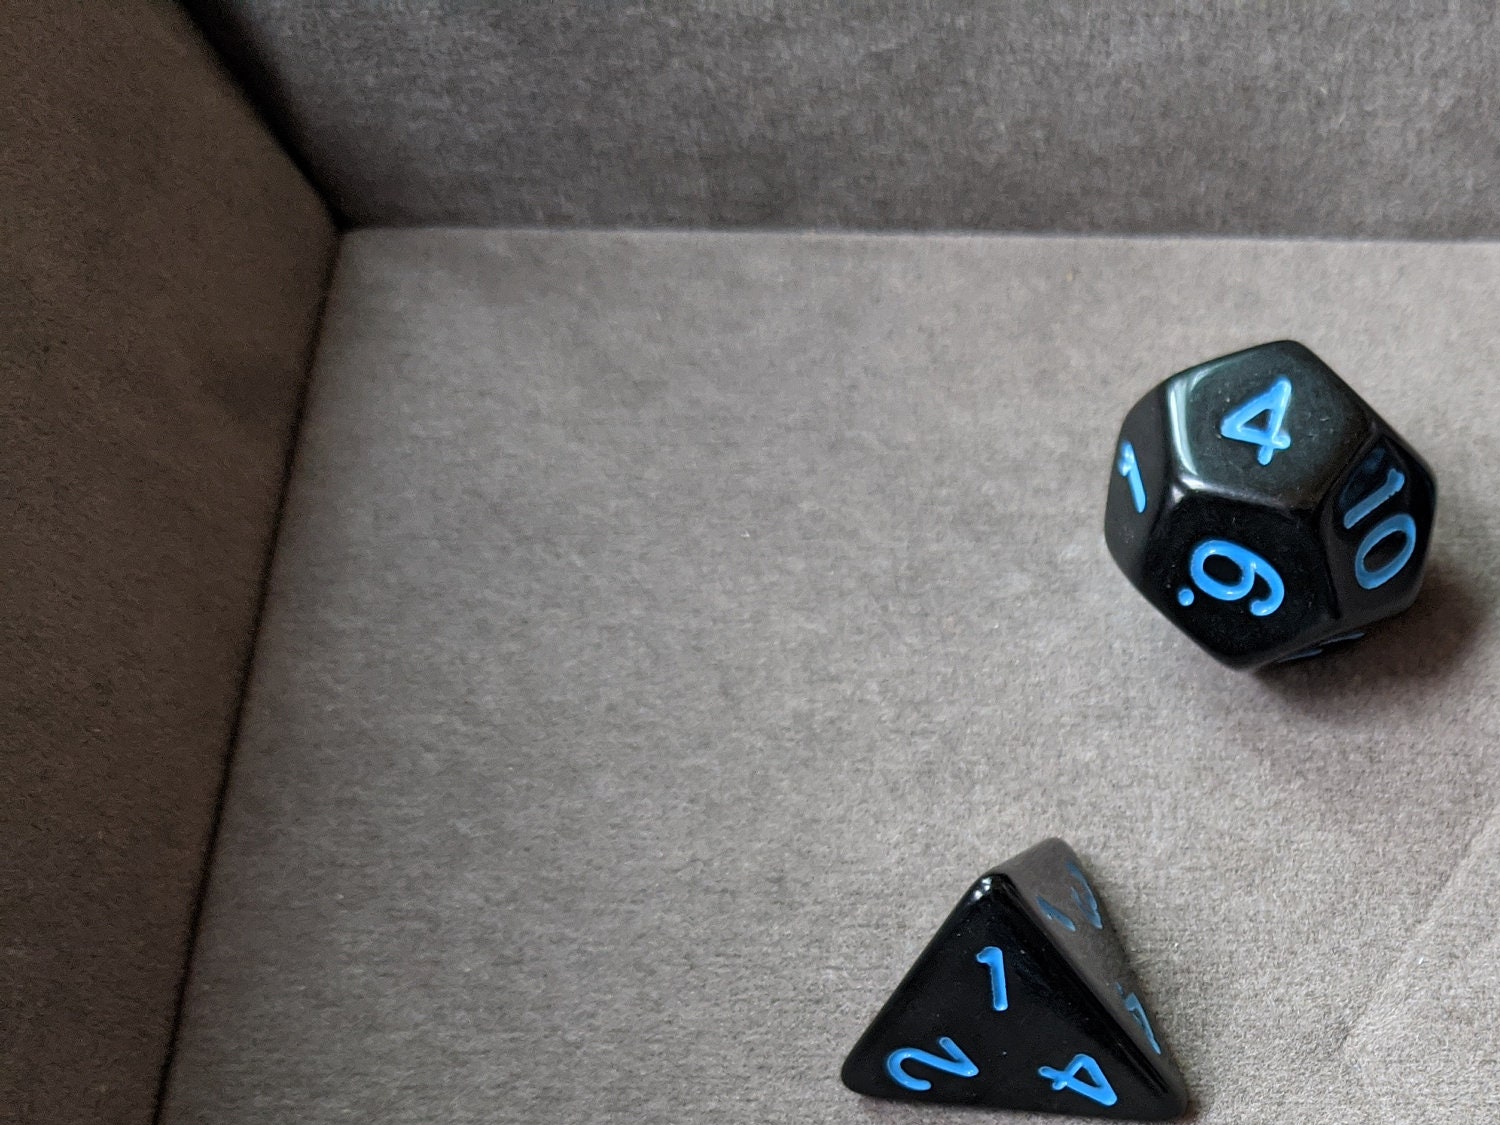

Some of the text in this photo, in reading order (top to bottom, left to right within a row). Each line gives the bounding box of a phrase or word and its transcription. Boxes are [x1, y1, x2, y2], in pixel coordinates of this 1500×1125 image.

[1219, 372, 1293, 467] 4
[1343, 467, 1417, 591] 10
[975, 945, 1009, 1012] 1
[885, 1036, 980, 1092] 2
[1037, 1053, 1118, 1107] 4
